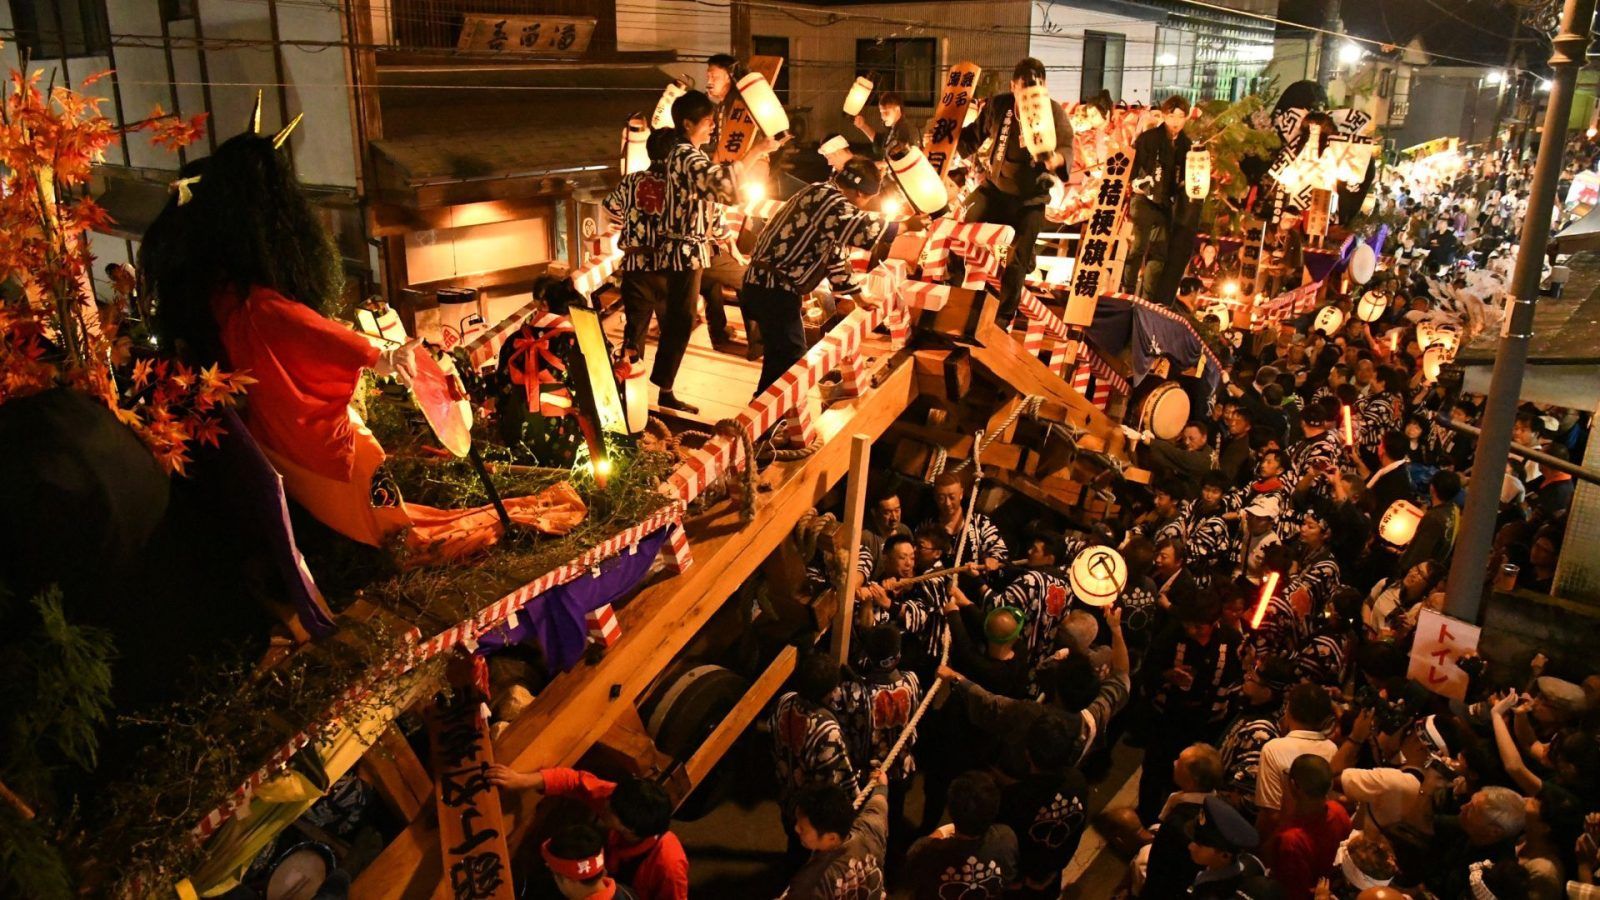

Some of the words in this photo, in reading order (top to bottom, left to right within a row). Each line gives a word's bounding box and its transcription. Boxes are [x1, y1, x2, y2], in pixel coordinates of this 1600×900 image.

[1074, 178, 1123, 297] 桔梗旗揚
[1428, 623, 1456, 684] トイレ
